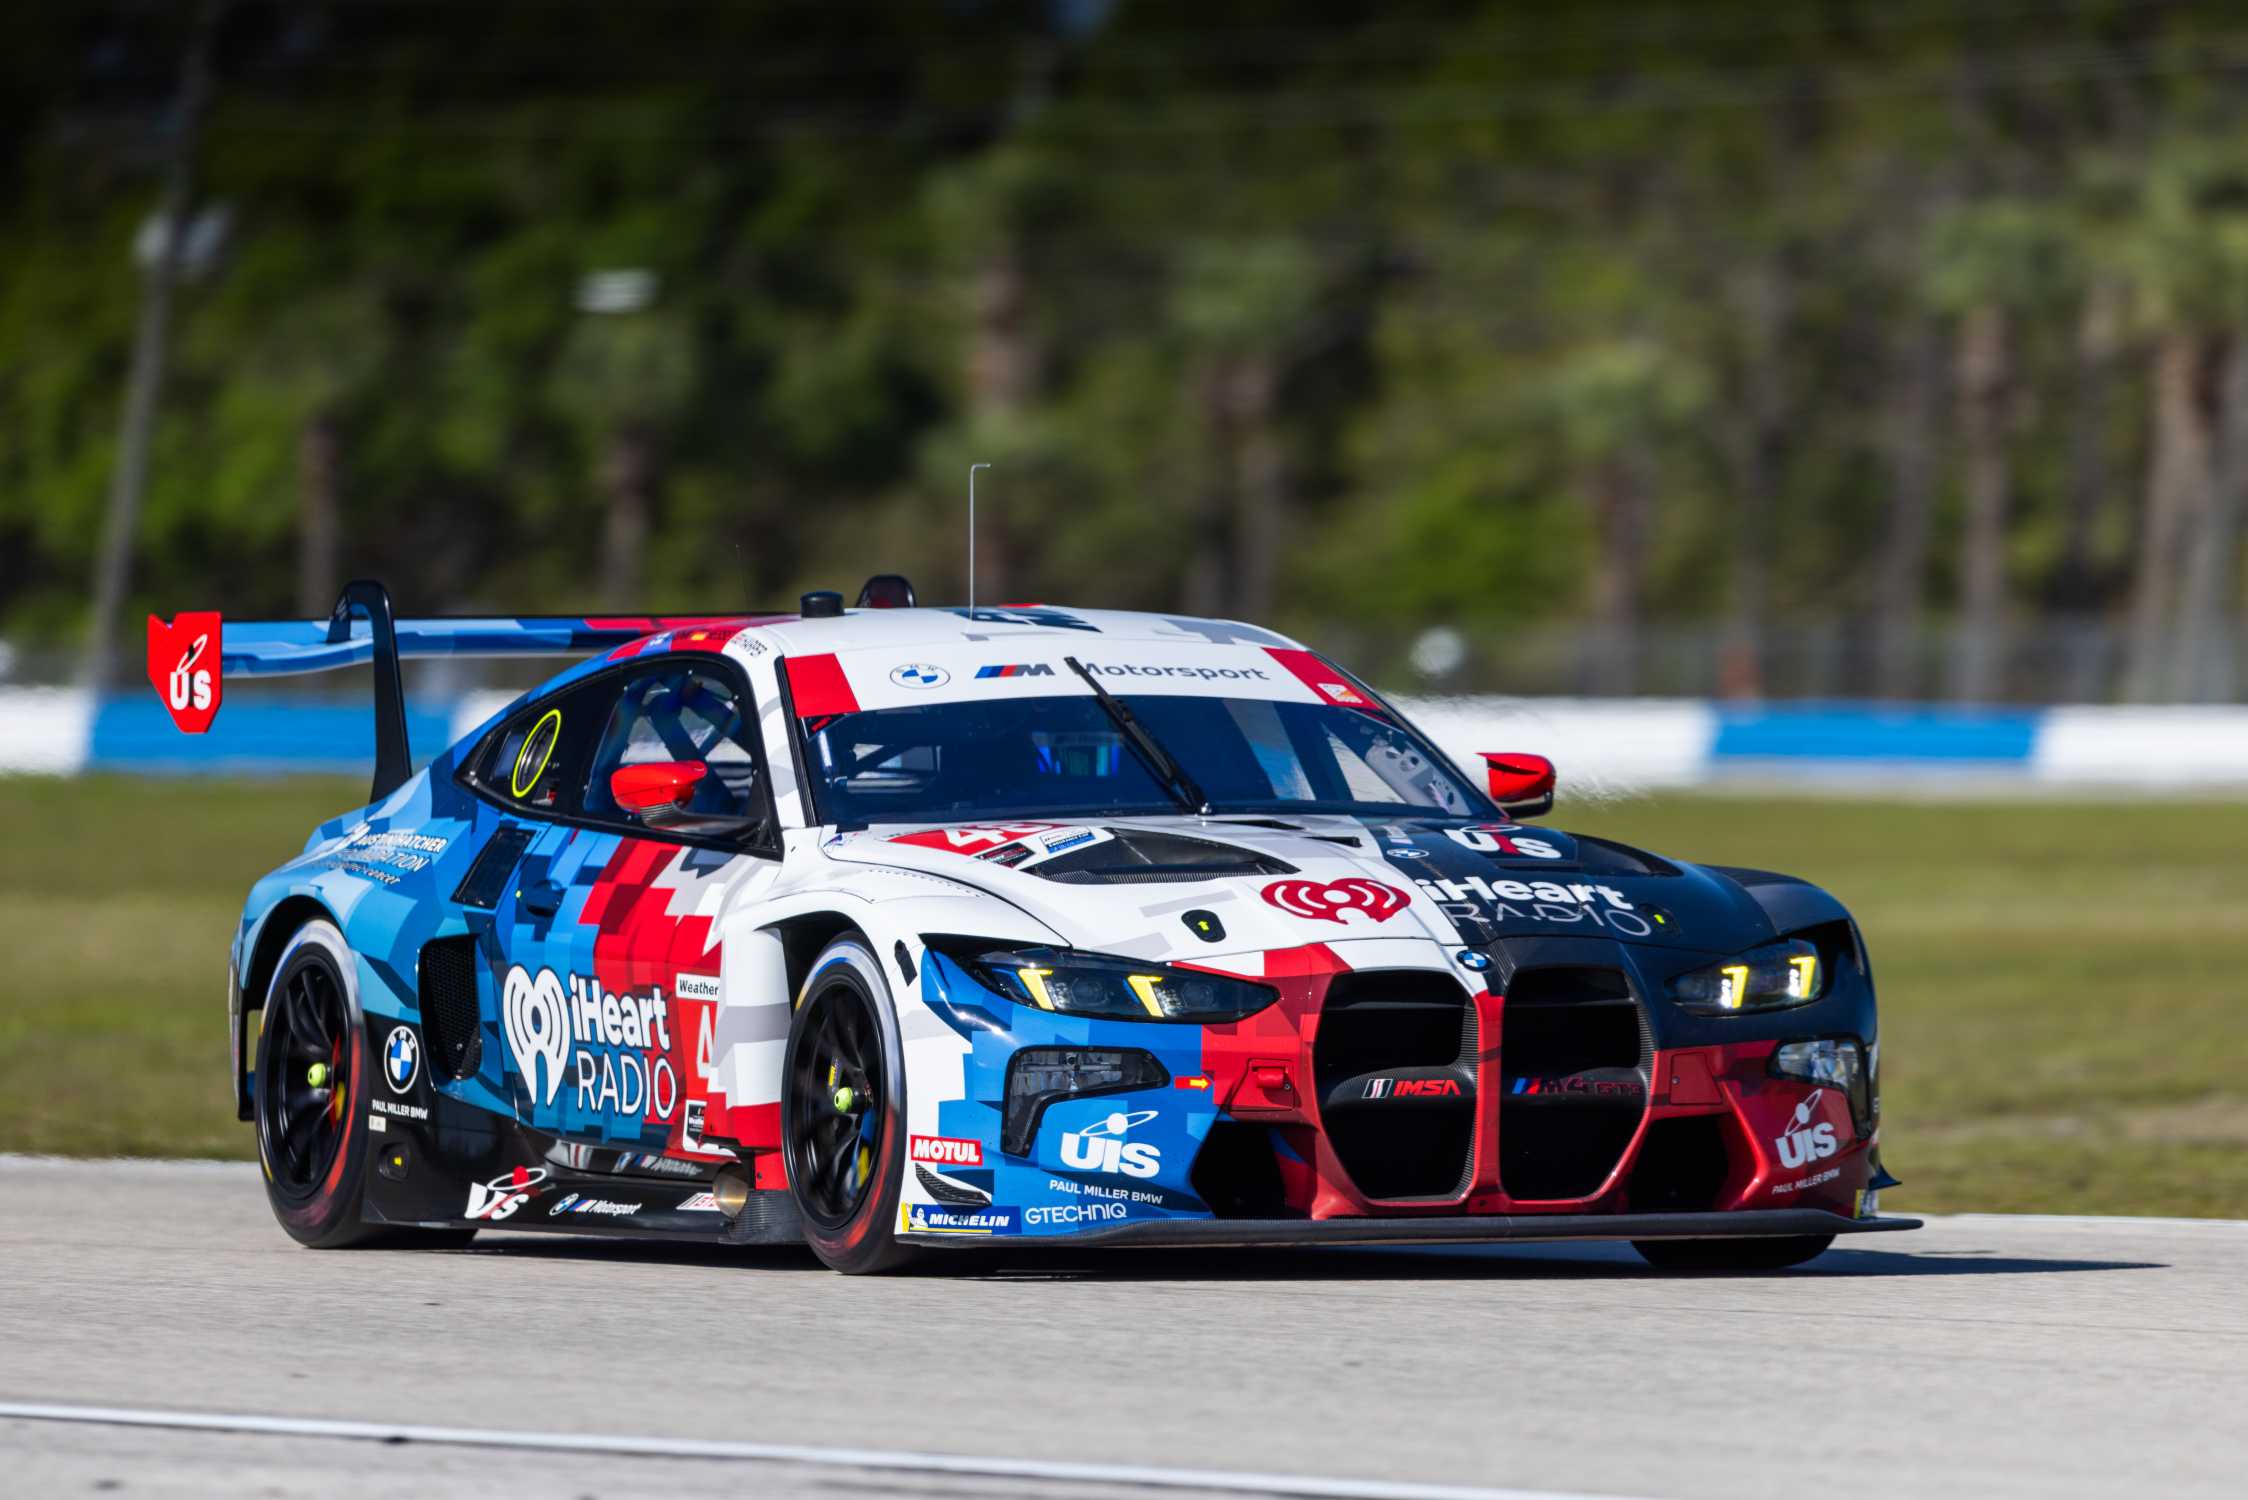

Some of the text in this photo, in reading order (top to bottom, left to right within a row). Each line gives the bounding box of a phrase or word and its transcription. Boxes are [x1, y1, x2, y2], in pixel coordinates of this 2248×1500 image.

[1415, 876, 1634, 910] iHeart
[1438, 903, 1652, 937] RADIO
[569, 972, 671, 1051] iHeart
[576, 1050, 677, 1119] RADIO
[1393, 1079, 1462, 1097] IMSA
[372, 1098, 428, 1120] PAUL MILLER BMW
[913, 1139, 980, 1163] MOTUL
[1060, 1132, 1161, 1178] UIS
[1775, 1122, 1838, 1169] UIS
[1049, 1179, 1164, 1205] PAUL MILLER BMW
[928, 1213, 1010, 1227] MICHELIN
[1025, 1202, 1128, 1225] GTECHNIQ
